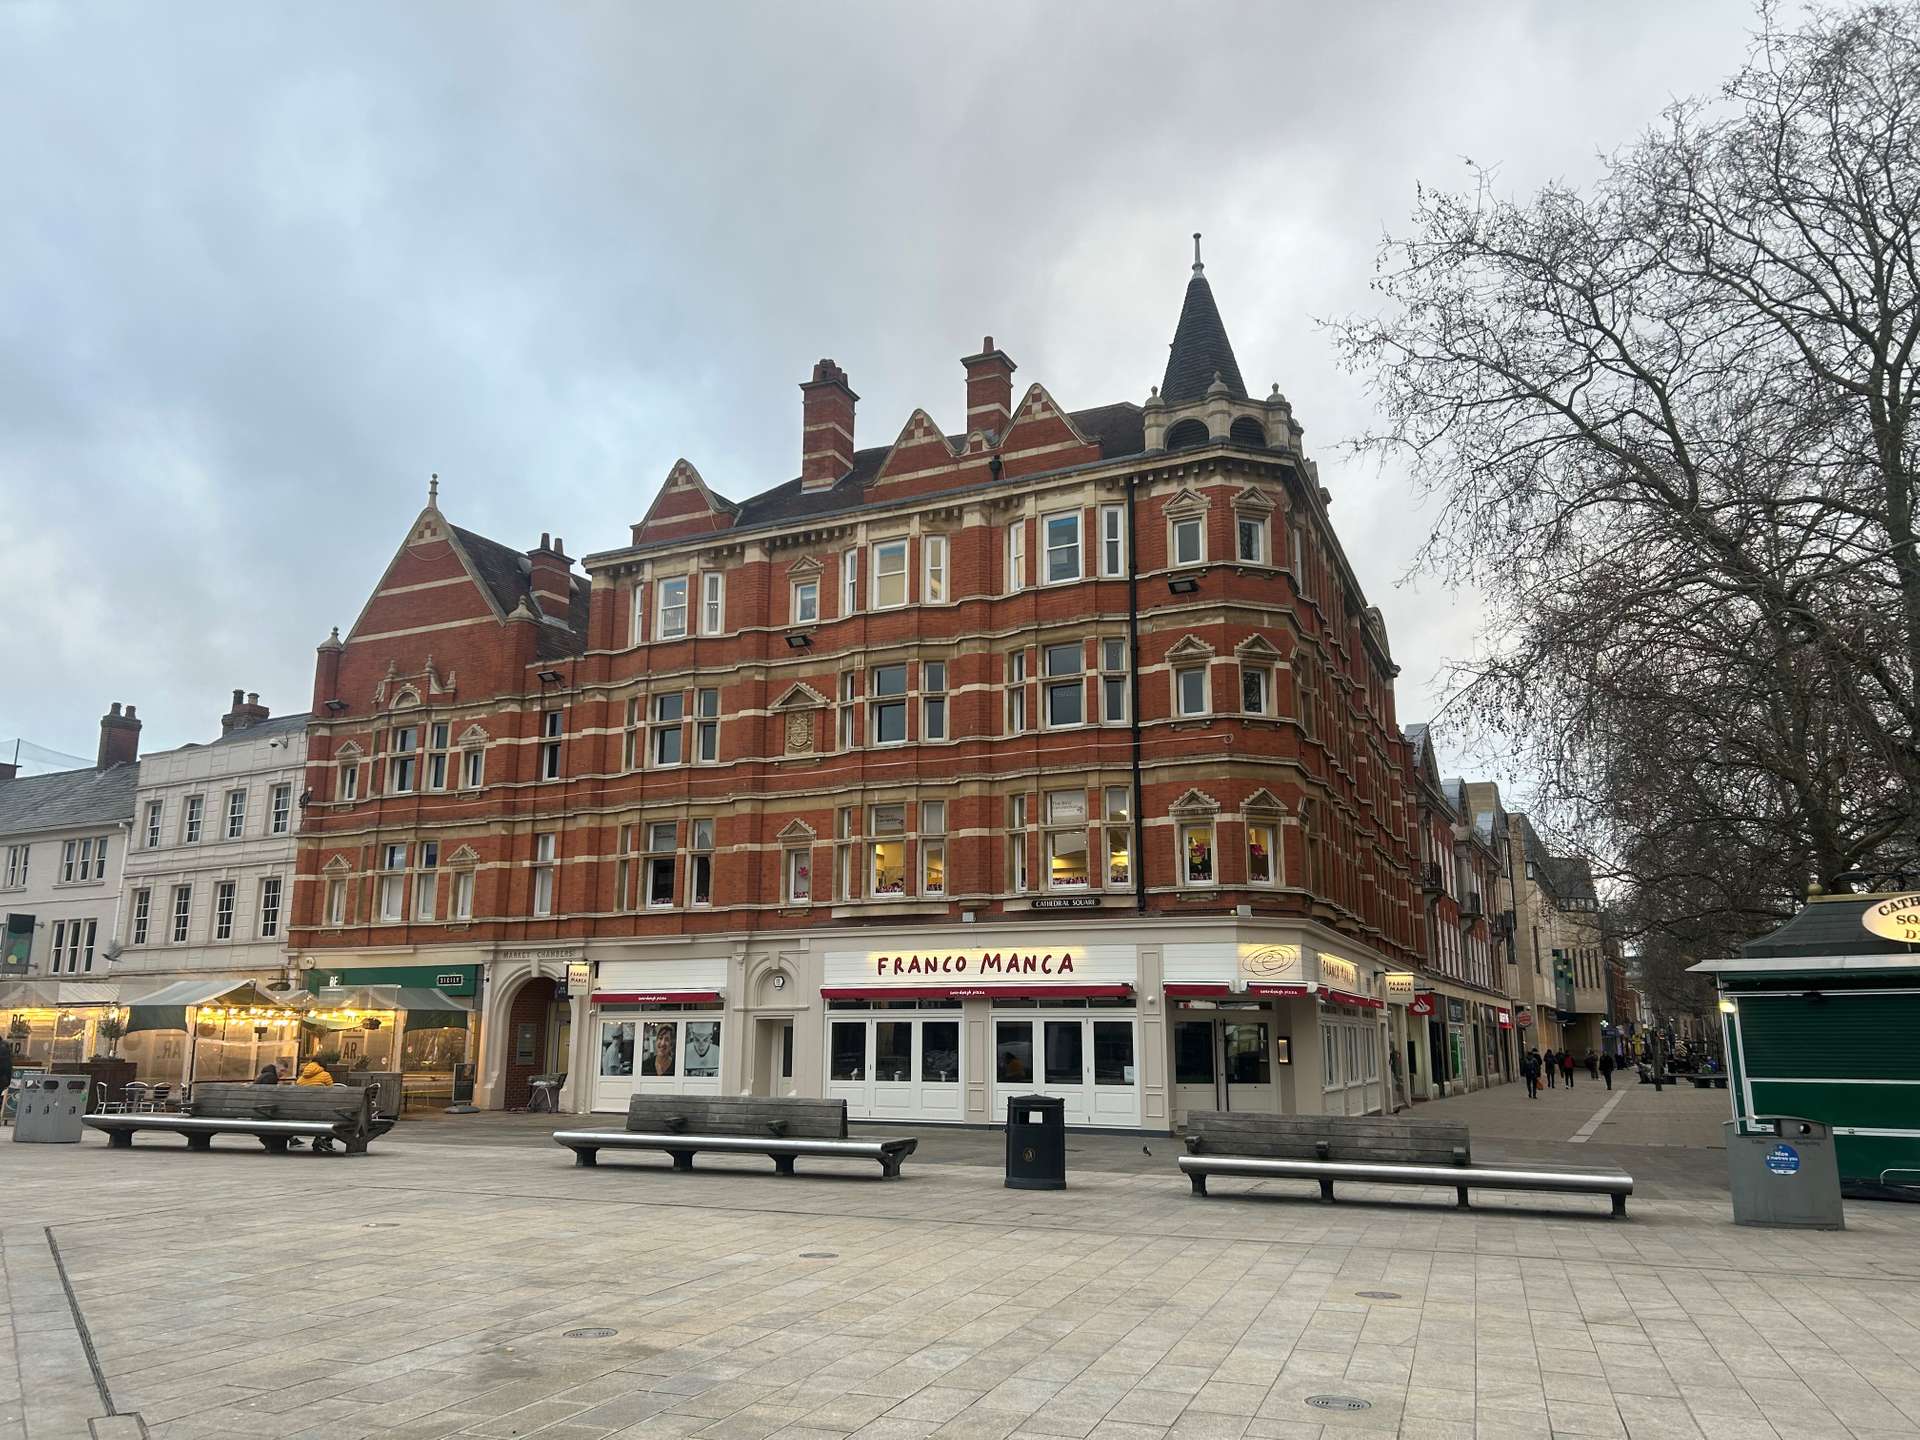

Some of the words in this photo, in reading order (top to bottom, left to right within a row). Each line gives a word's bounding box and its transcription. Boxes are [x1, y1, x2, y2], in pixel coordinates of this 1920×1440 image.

[1896, 914, 1920, 925] SQ
[503, 951, 531, 959] MARKET
[536, 950, 574, 958] CHAMBERS
[877, 955, 967, 975] FRANCO
[980, 953, 1074, 974] MANCA
